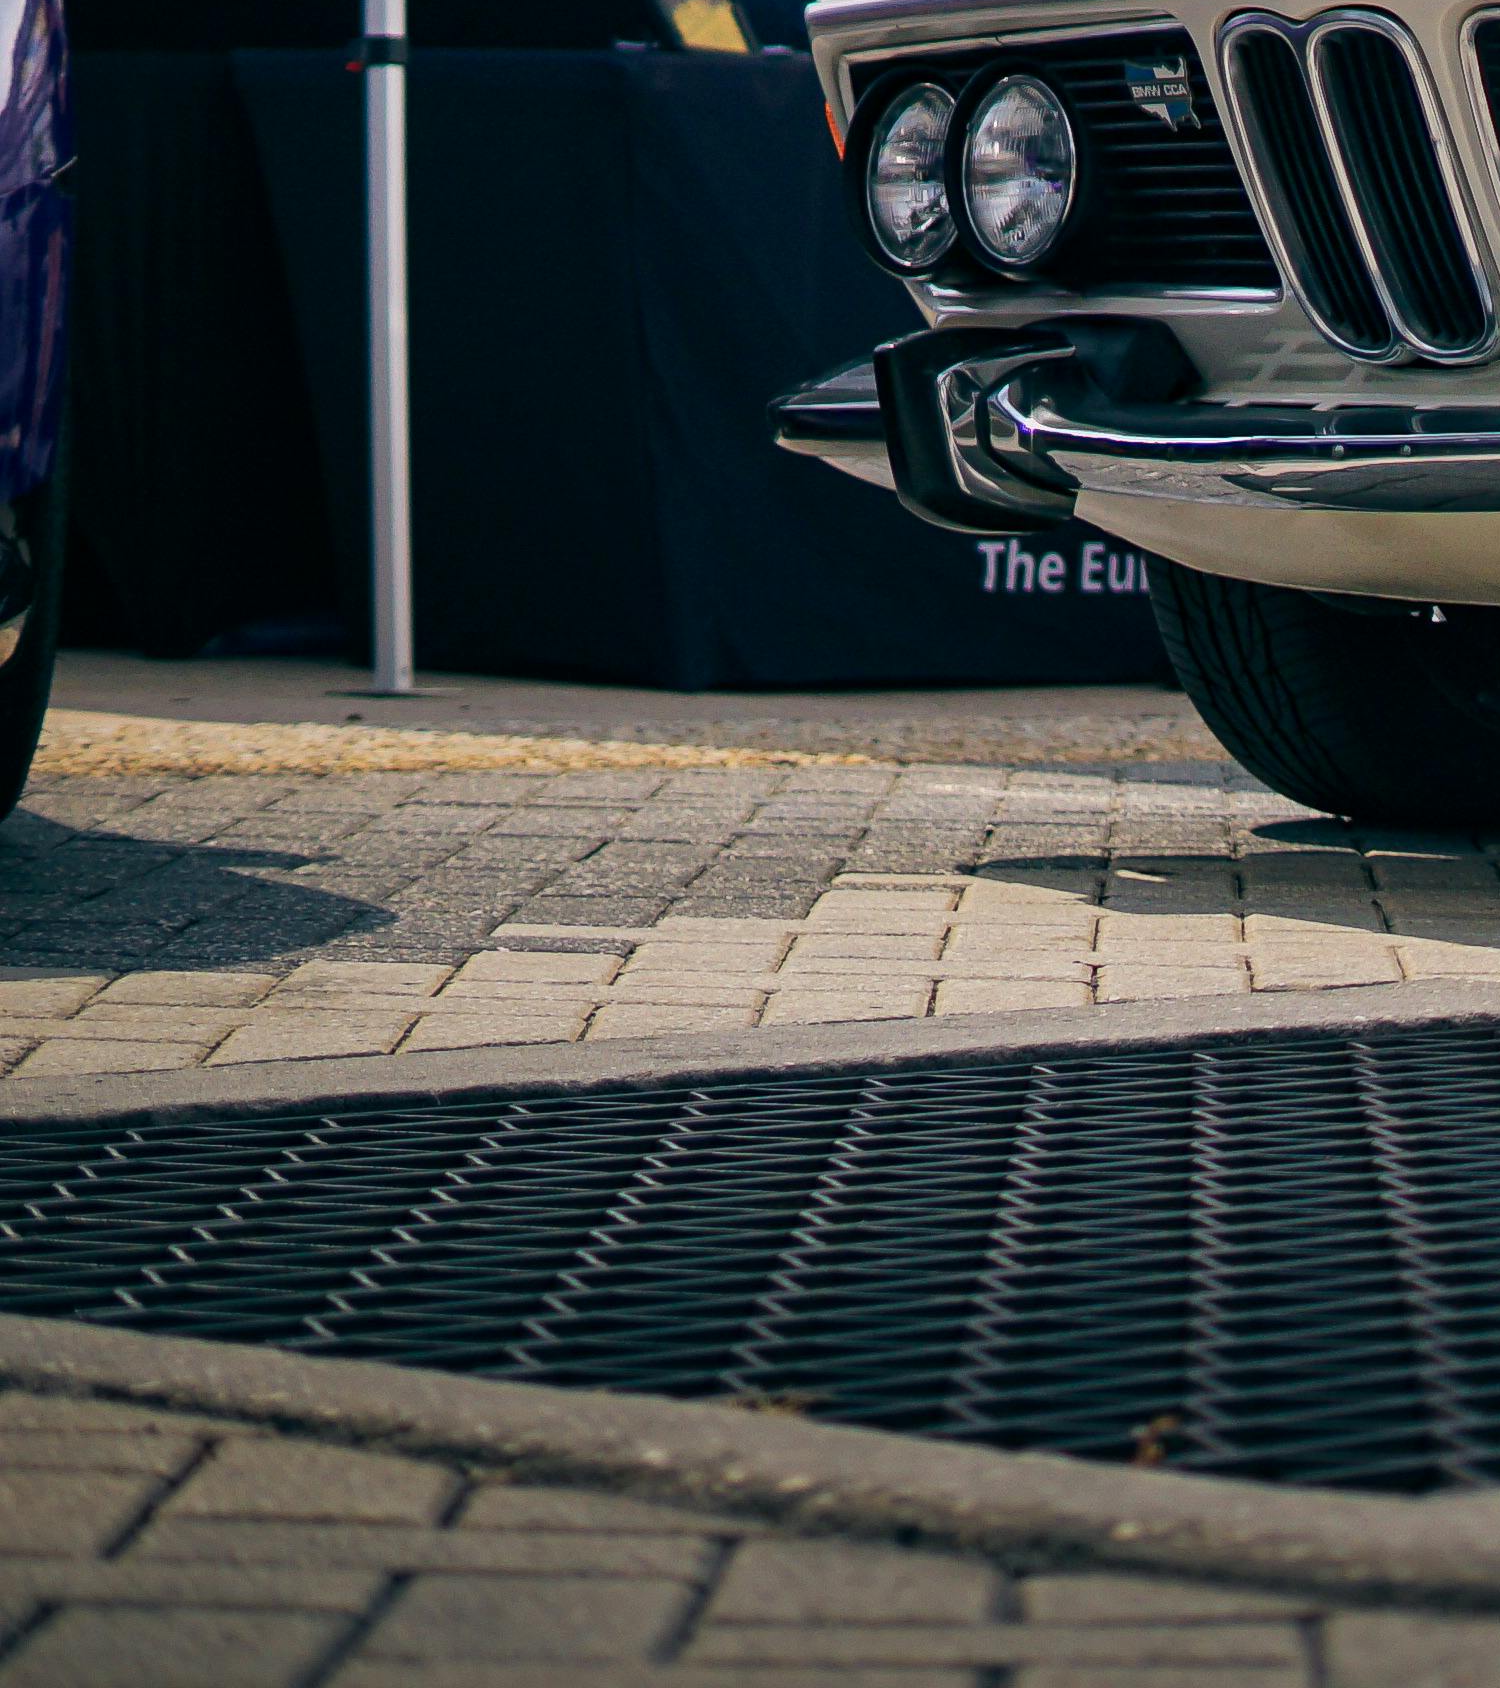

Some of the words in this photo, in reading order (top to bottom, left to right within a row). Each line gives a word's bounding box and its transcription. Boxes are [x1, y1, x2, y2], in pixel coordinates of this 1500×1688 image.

[1131, 84, 1161, 98] BMW
[1163, 83, 1188, 97] CCA
[977, 541, 1066, 593] The
[1081, 542, 1150, 593] Eur
